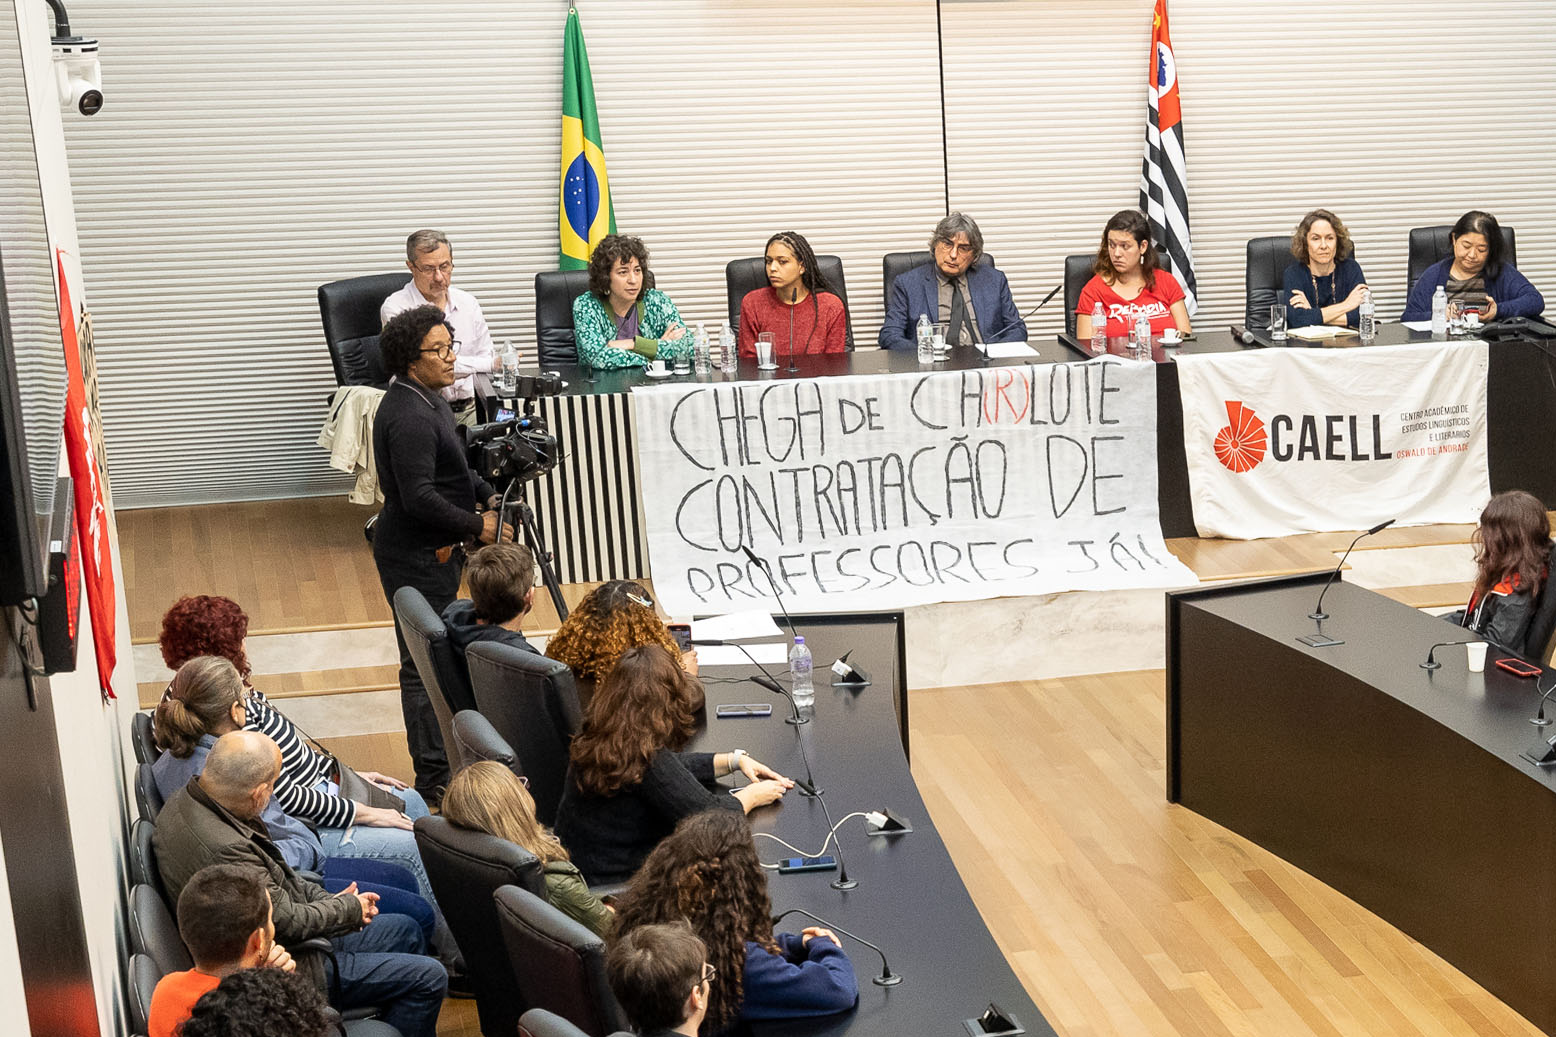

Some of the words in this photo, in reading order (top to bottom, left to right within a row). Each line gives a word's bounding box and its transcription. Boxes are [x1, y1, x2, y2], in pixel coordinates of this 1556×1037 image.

[669, 381, 826, 471] CHEGA
[838, 397, 885, 435] DE
[1271, 413, 1393, 462] CAELL
[1400, 410, 1423, 422] CENTRO
[1401, 421, 1428, 434] ESTUDOS
[1396, 447, 1426, 459] OSWALD
[1427, 446, 1437, 456] DE
[676, 434, 1007, 553] CONTRATAÇÃO
[1046, 433, 1127, 519] DE
[687, 537, 1039, 603] PROFESSORES
